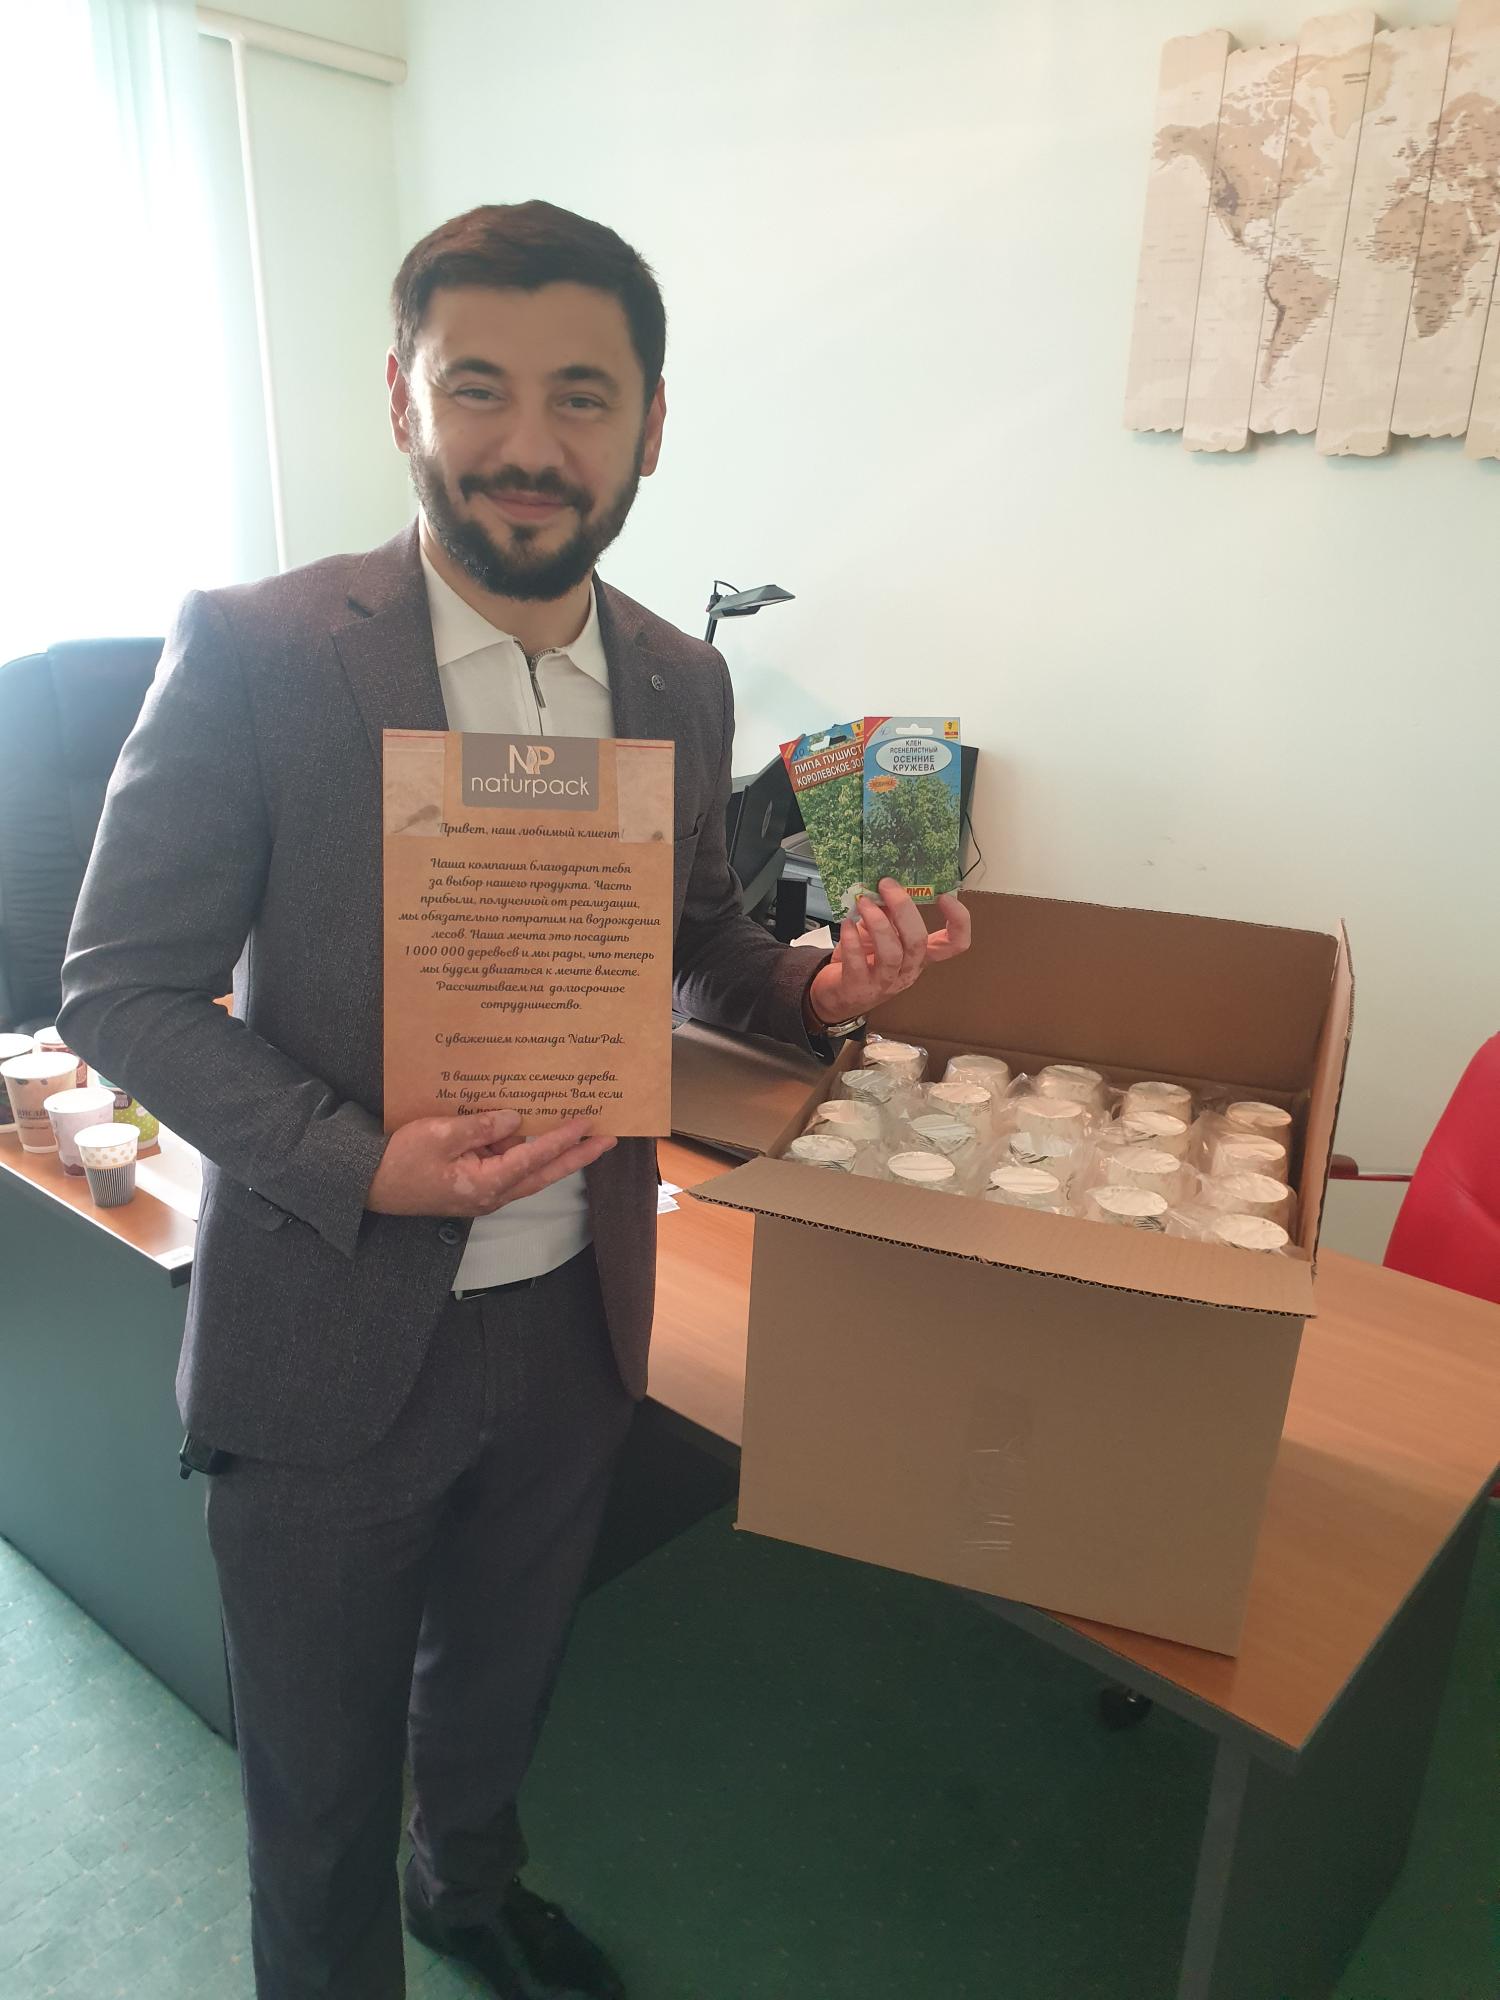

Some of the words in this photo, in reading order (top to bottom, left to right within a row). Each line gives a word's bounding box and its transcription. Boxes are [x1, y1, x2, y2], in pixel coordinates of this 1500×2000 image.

[889, 746, 938, 754] ЯСЕНЕЛИСТНЫЙ
[794, 758, 822, 774] ЛИПА
[822, 744, 864, 766] ПУШИСТ
[893, 755, 935, 763] ОСЕННИЕ
[796, 761, 852, 787] КОРОЛЕВСКОЕ
[893, 763, 935, 772] КРУЖЕВА
[471, 773, 590, 798] naturpack
[440, 823, 488, 837] Привет,
[518, 825, 575, 837] любимый
[431, 858, 465, 868] Наша
[469, 862, 527, 870] компания
[530, 860, 599, 876] благодарит
[602, 863, 632, 873] тебя
[429, 879, 443, 889] за
[446, 875, 483, 891] выбор
[486, 880, 527, 888] нашего
[594, 880, 631, 890] Часть
[906, 887, 932, 897] ЛИТА
[480, 896, 548, 909] полученной
[570, 900, 640, 911] реализации,
[421, 910, 499, 925] обязательно
[502, 916, 566, 927] потратим
[586, 914, 661, 929] возрождения
[470, 929, 504, 939] Наша
[574, 934, 629, 945] посадить
[406, 946, 409, 955] 1
[413, 946, 437, 955] 000
[441, 946, 465, 956] 000
[467, 946, 519, 960] деревьев
[552, 951, 585, 962] рады,
[614, 952, 654, 963] теперь
[443, 964, 479, 977] будем
[482, 964, 542, 978] двигаться
[595, 965, 639, 976] вместе.
[436, 981, 528, 992] Рассчитываем
[549, 986, 625, 997] долгосрочное
[481, 999, 582, 1013] сотрудничество.
[435, 1033, 443, 1043] С
[446, 1033, 512, 1047] уважением
[515, 1036, 565, 1047] команда
[441, 1072, 450, 1081] В
[453, 1071, 491, 1081] ваших
[492, 1074, 526, 1085] руках
[436, 1089, 456, 1098] Мы
[460, 1088, 496, 1102] будем
[499, 1088, 567, 1102] благодарны
[570, 1088, 595, 1098] Вам
[457, 1105, 475, 1116] вы
[561, 1105, 602, 1119] дерево!
